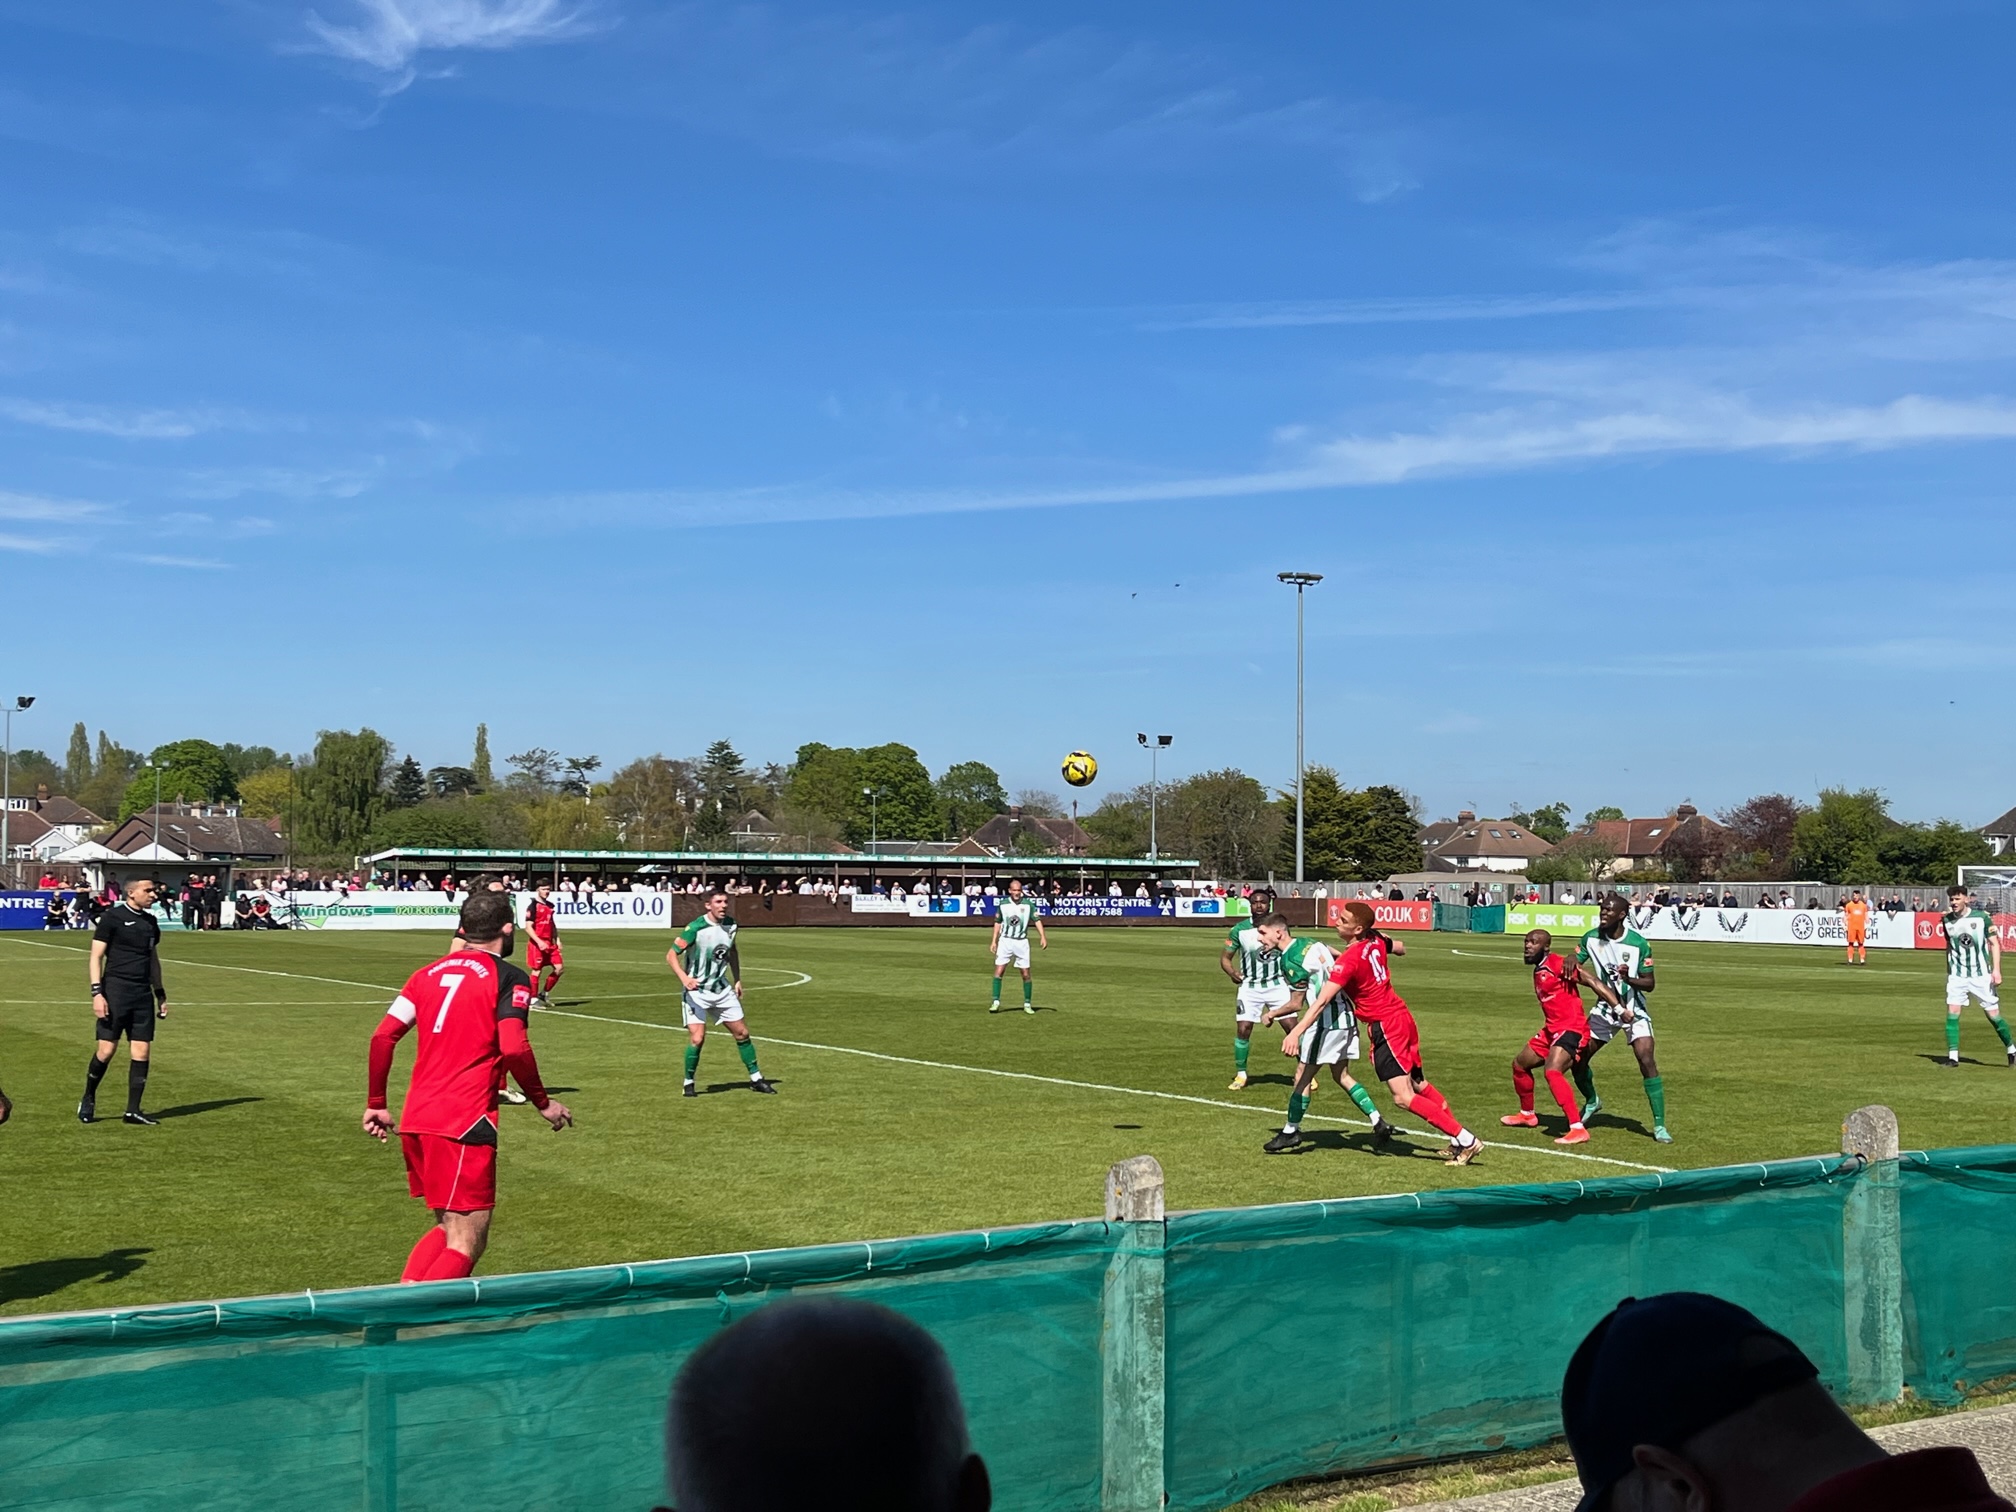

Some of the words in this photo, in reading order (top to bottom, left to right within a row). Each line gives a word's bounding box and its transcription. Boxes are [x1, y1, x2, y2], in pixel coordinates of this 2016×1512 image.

[556, 897, 624, 915] ineken
[632, 897, 664, 916] 0.0
[1054, 898, 1108, 907] MOTORIST
[1112, 898, 1152, 907] CENTRE
[442, 905, 461, 916] 179
[1051, 908, 1076, 916] 0208
[1079, 908, 1097, 916] 298
[1099, 908, 1123, 916] 7588
[462, 959, 489, 978] SPORTS
[432, 973, 466, 1033] 7
